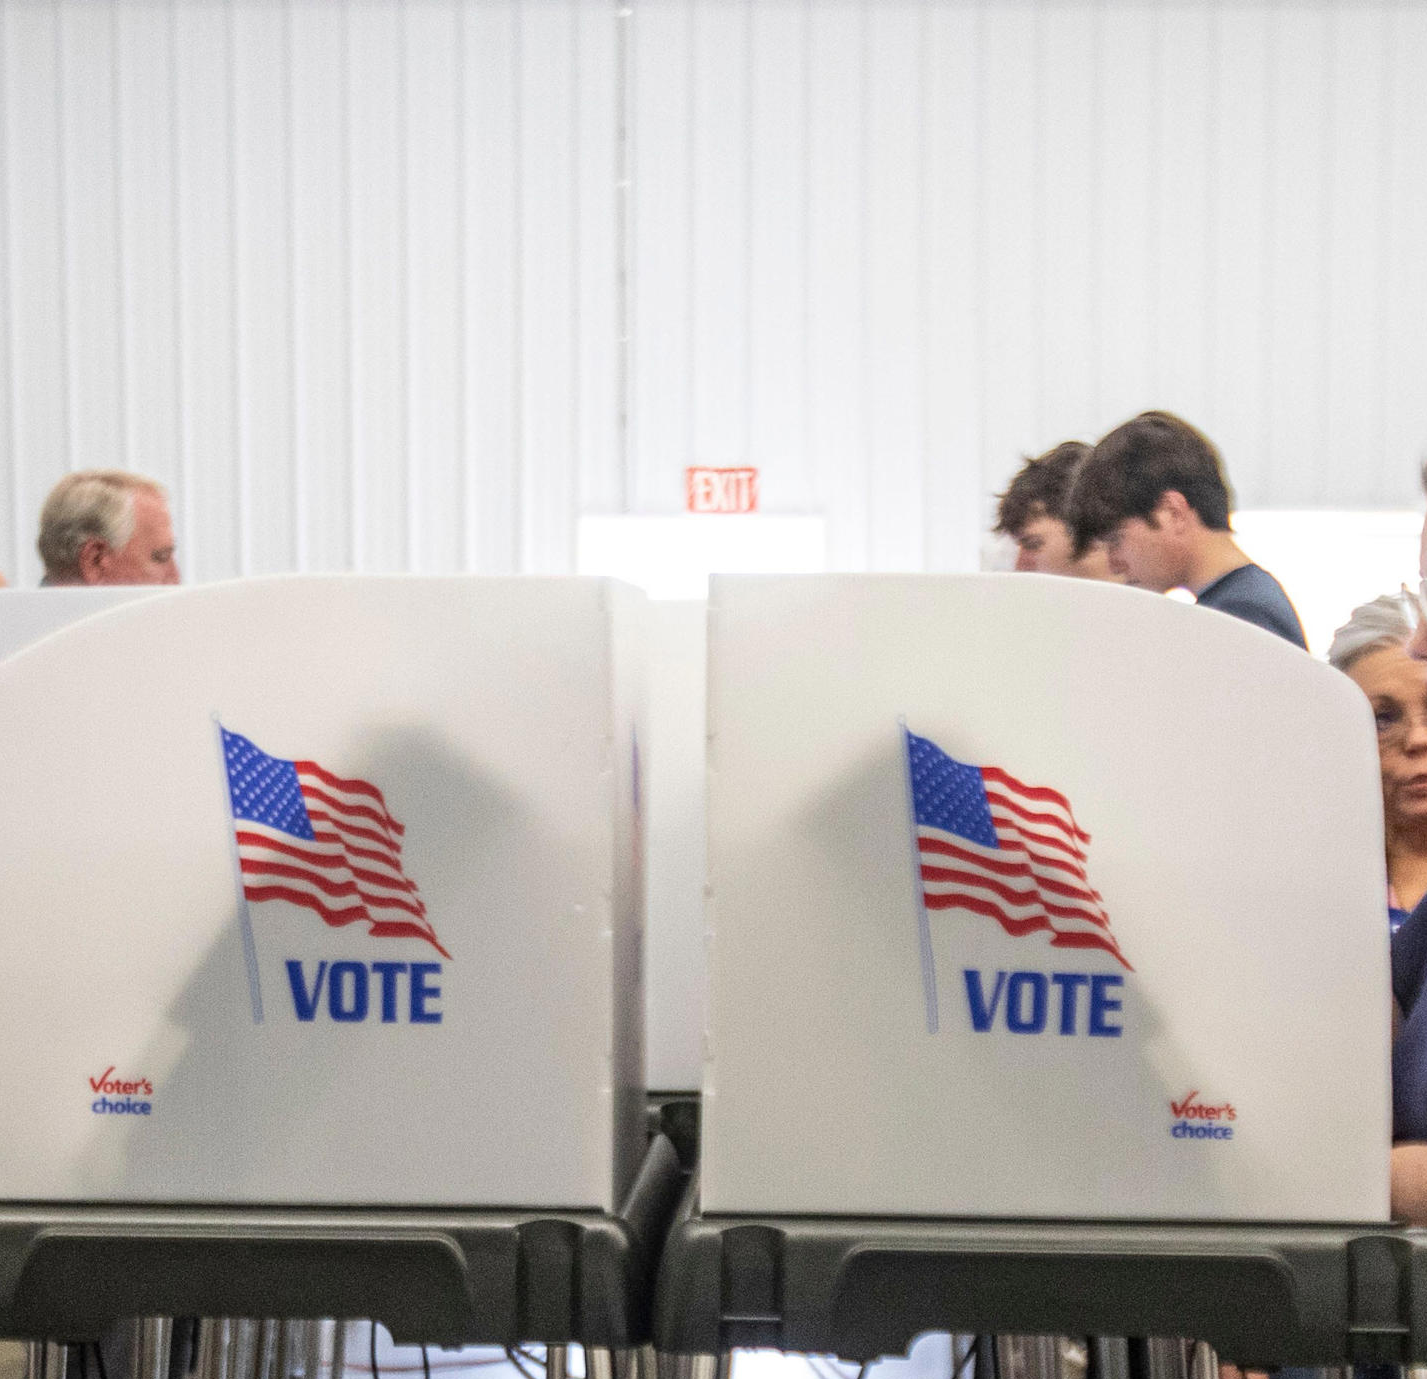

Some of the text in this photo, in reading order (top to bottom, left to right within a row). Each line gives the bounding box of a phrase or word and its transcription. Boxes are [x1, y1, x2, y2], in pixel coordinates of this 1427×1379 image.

[693, 471, 754, 511] EXIT
[285, 960, 443, 1023] VOTE
[963, 969, 1124, 1037] VOTE
[89, 1066, 153, 1095] Voter's
[91, 1097, 152, 1115] choice
[1170, 1090, 1236, 1121] Voter's
[1171, 1121, 1234, 1140] choice
